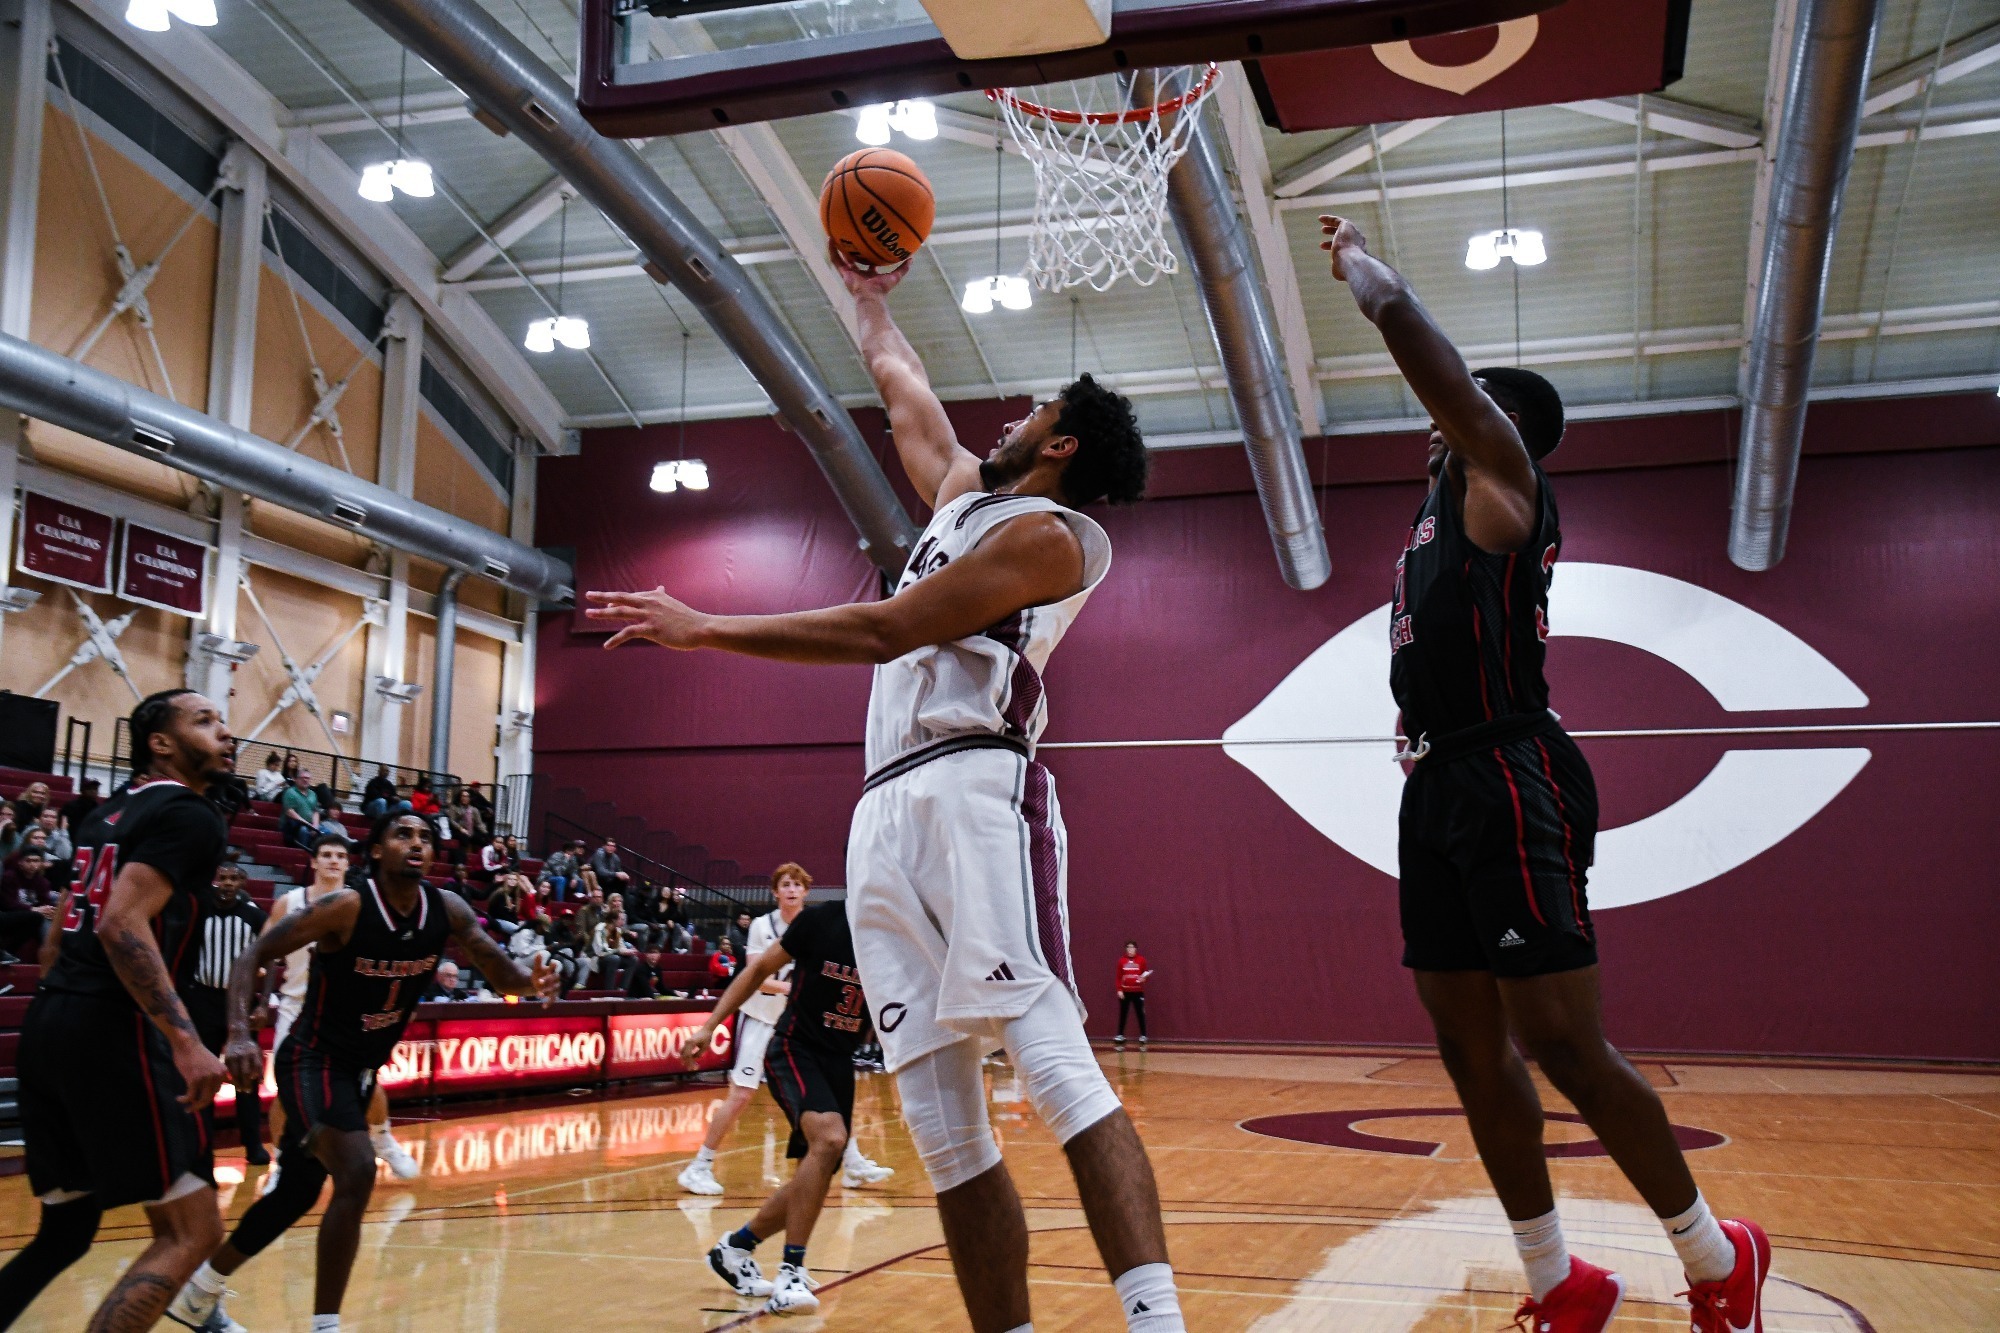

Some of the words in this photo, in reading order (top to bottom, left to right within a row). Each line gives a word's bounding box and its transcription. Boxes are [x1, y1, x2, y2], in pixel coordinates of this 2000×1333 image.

[861, 204, 912, 261] Wilson
[62, 843, 120, 934] 24
[382, 980, 401, 1011] 1
[836, 984, 865, 1017] 31
[460, 1036, 498, 1074] OF
[499, 1031, 606, 1072] CHICAGO
